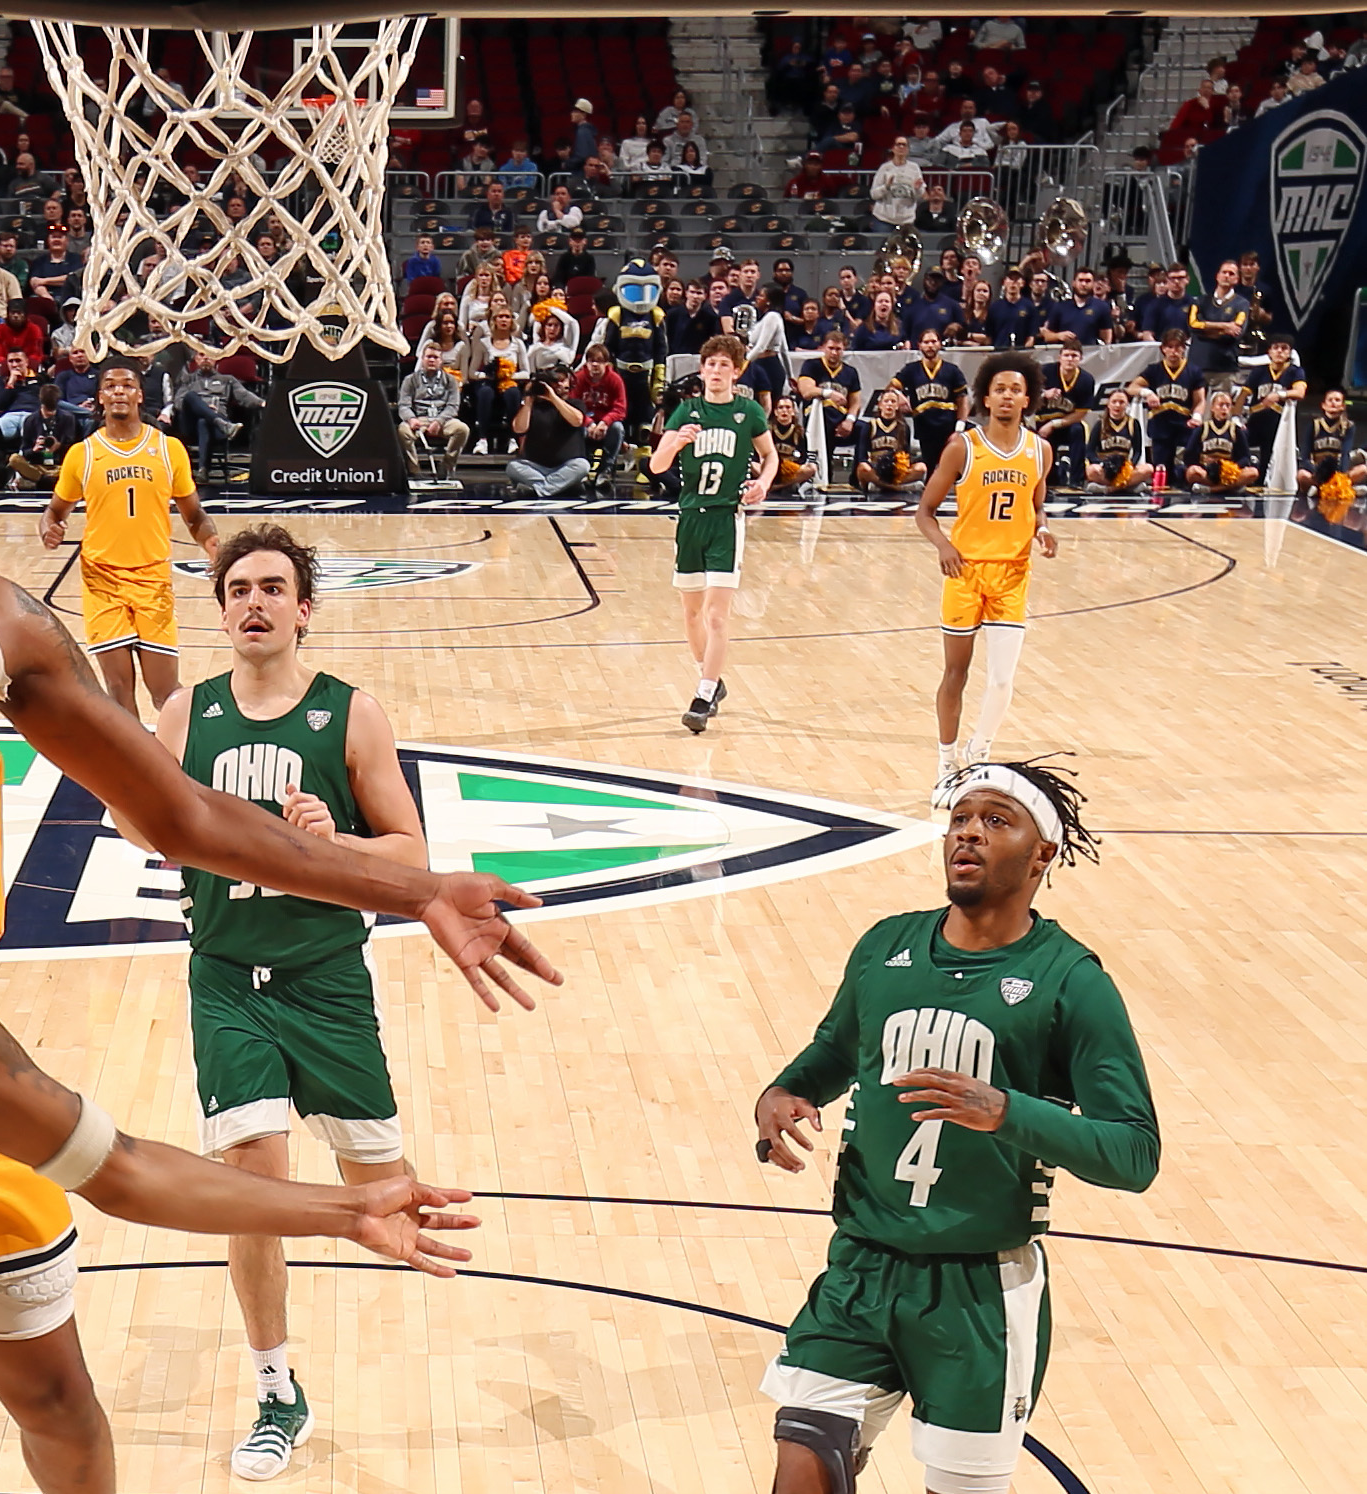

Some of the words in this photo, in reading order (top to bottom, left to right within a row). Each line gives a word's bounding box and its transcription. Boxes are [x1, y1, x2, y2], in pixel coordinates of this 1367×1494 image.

[1275, 183, 1355, 234] MAC
[916, 383, 949, 400] TOLEDO
[1156, 384, 1188, 400] TOLEDO
[297, 406, 359, 424] MAC
[693, 428, 737, 459] OHIO
[1202, 437, 1233, 452] TOLEDO
[105, 466, 154, 486] ROCKETS
[270, 468, 323, 483] Credit
[324, 468, 375, 483] Union
[697, 461, 724, 495] 13
[982, 469, 1028, 487] ROCKETS
[124, 485, 137, 518] 1
[988, 490, 1015, 521] 12
[212, 743, 304, 806] OHIO
[880, 1006, 996, 1086] OHIO
[894, 1116, 943, 1209] 4
